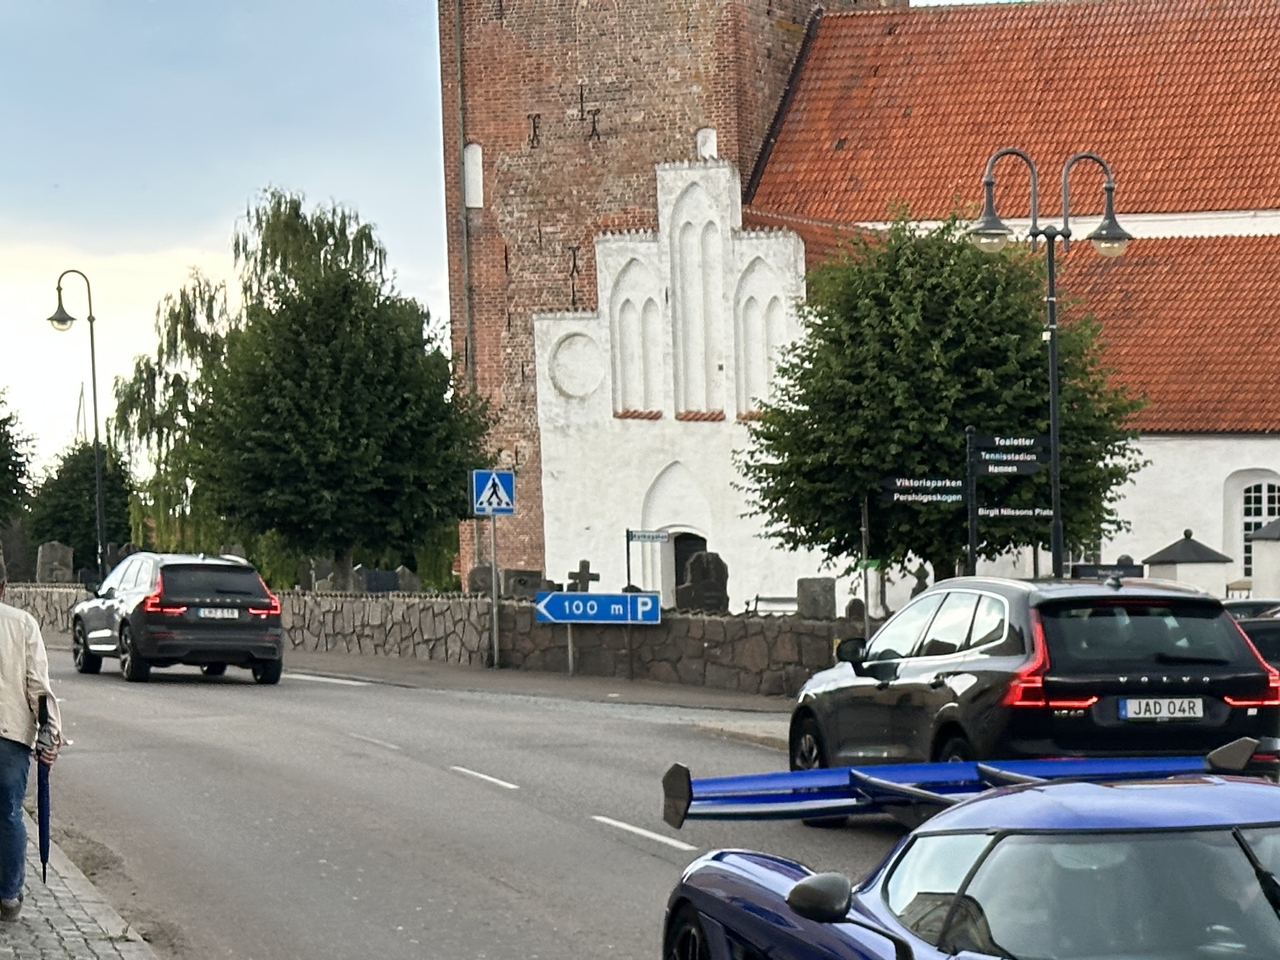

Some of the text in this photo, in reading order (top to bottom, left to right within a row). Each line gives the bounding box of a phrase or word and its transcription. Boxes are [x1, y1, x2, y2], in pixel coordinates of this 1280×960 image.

[994, 436, 1035, 446] Toaletter
[980, 451, 1037, 461] Tennisstadion
[895, 478, 963, 491] Viktoriaparken
[893, 492, 963, 503] Pershögsskogen
[978, 507, 1054, 517] Birgit Nilssons Plats
[563, 597, 652, 620] 100 m P
[1134, 701, 1197, 715] JAD 04R
